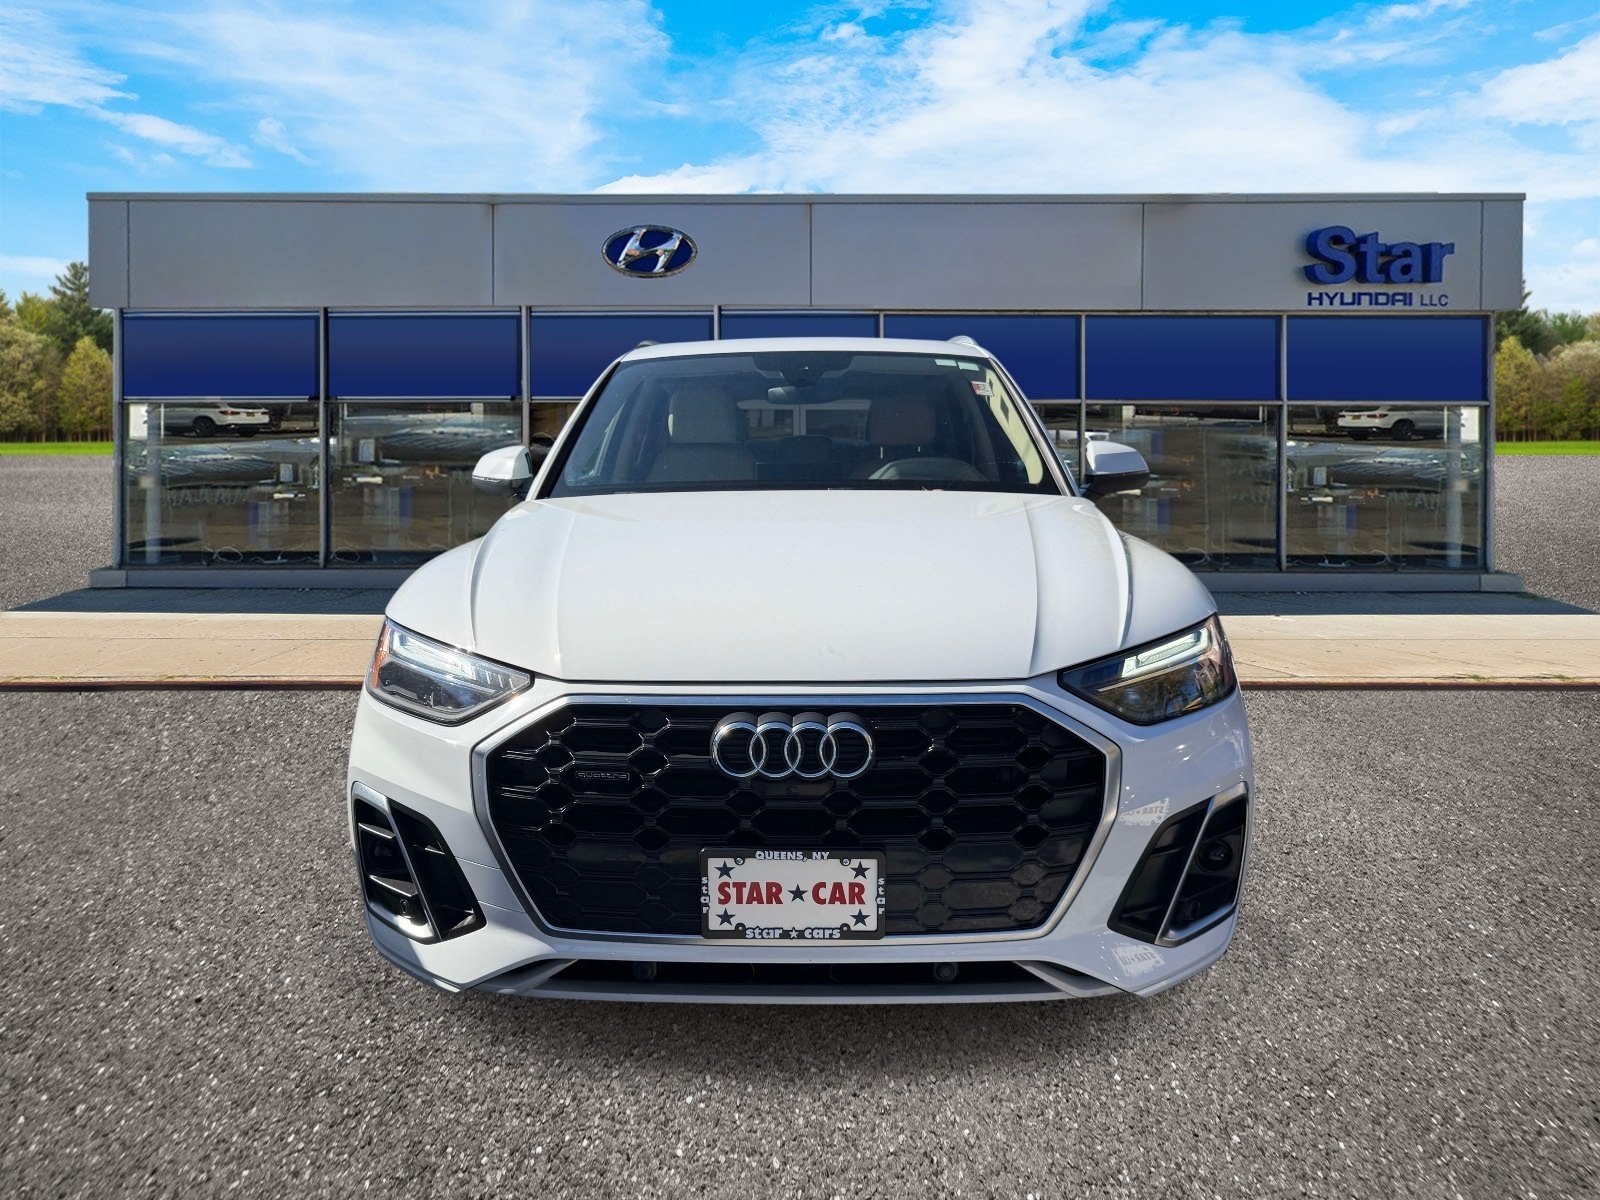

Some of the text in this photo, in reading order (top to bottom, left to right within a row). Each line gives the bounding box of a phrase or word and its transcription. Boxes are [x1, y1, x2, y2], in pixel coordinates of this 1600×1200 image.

[1303, 225, 1455, 285] Star
[1307, 292, 1449, 306] HYUNDAI LLC
[755, 851, 830, 862] QUEENS, NY
[717, 881, 866, 905] STAR CAR
[745, 927, 841, 939] star cars
